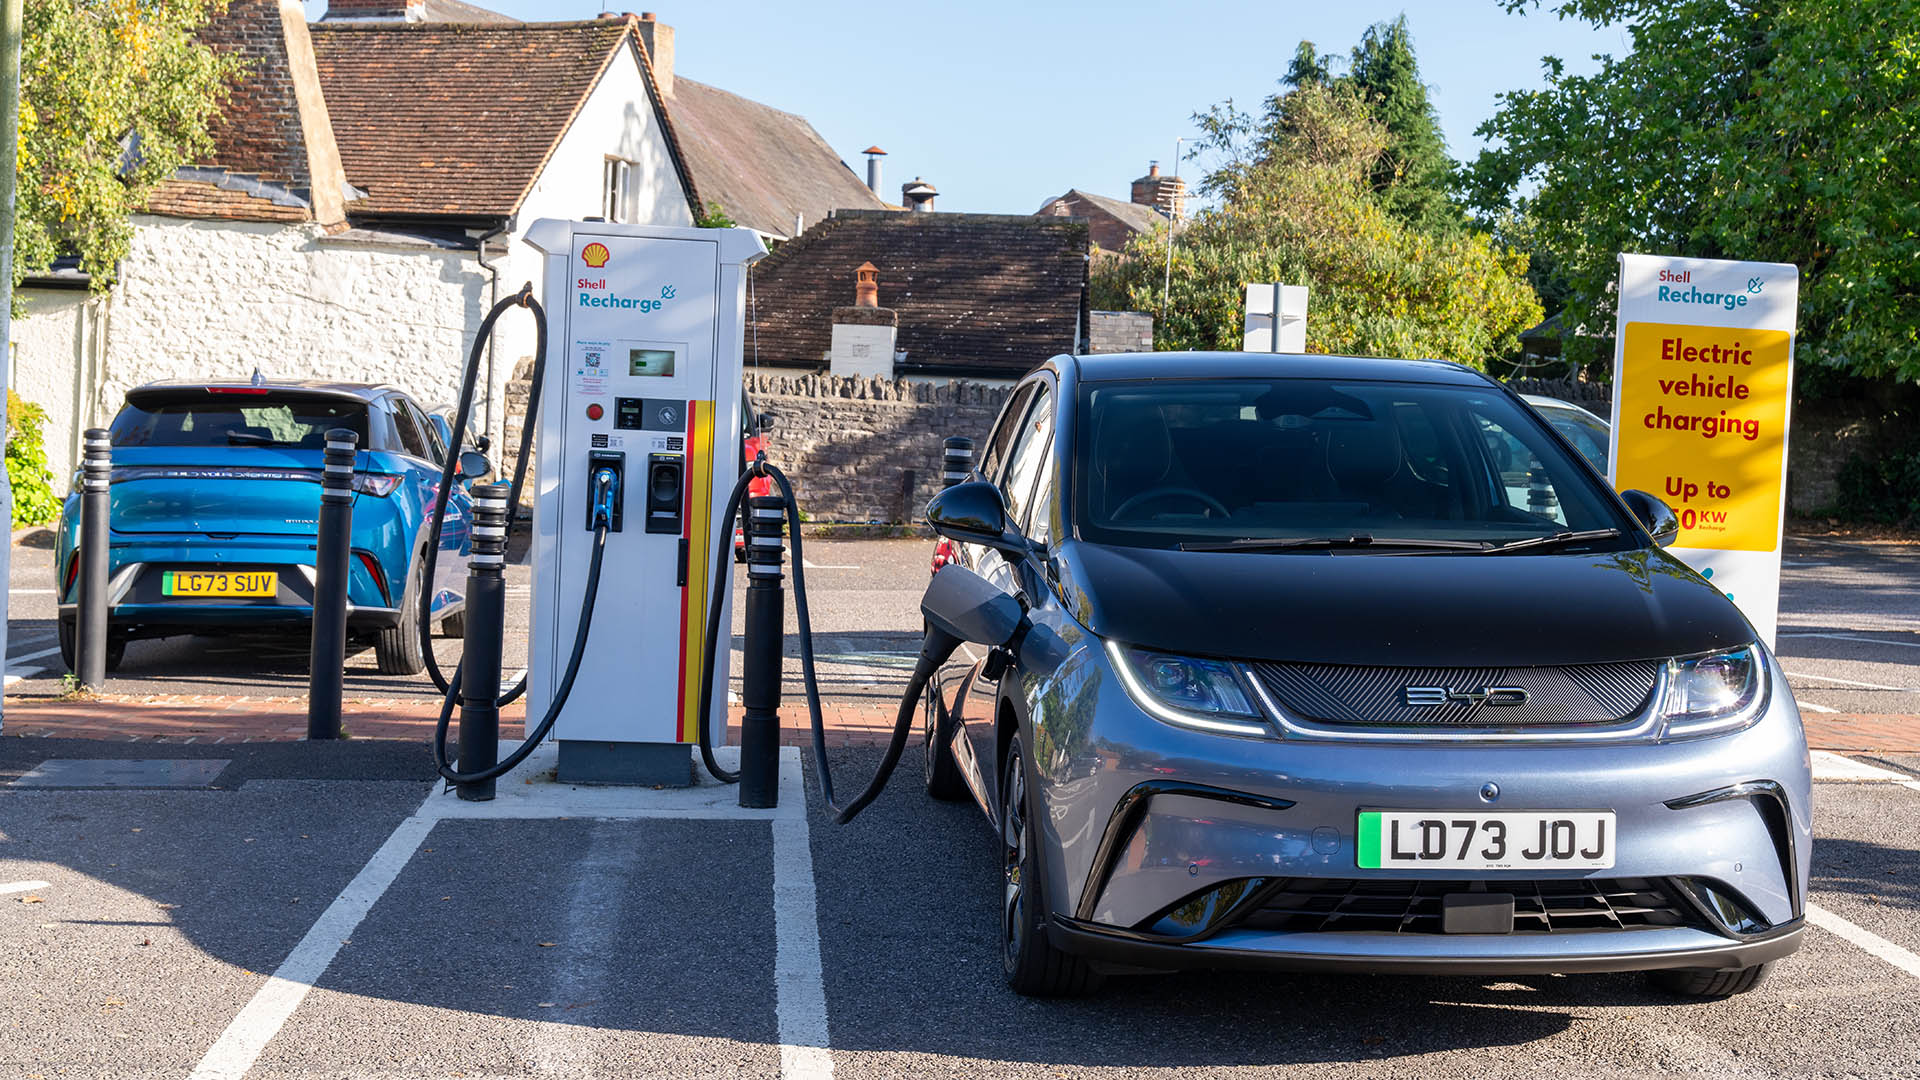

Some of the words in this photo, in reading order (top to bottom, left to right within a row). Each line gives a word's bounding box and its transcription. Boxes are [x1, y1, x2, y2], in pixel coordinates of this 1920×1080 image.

[577, 278, 606, 290] Shell
[1659, 270, 1691, 283] Shell
[579, 293, 662, 313] Recharge
[1658, 285, 1748, 310] Recharge
[1661, 338, 1752, 366] Electric
[1658, 373, 1750, 400] vehicle
[1644, 405, 1760, 441] charging
[1665, 477, 1699, 503] Up
[1707, 481, 1731, 499] to
[1672, 508, 1697, 530] 0
[1700, 511, 1728, 523] KW
[177, 575, 228, 592] LG73
[234, 575, 272, 592] SUV
[1405, 686, 1531, 705] BYD
[1390, 820, 1507, 860] LD73
[1521, 819, 1606, 860] JOJ
